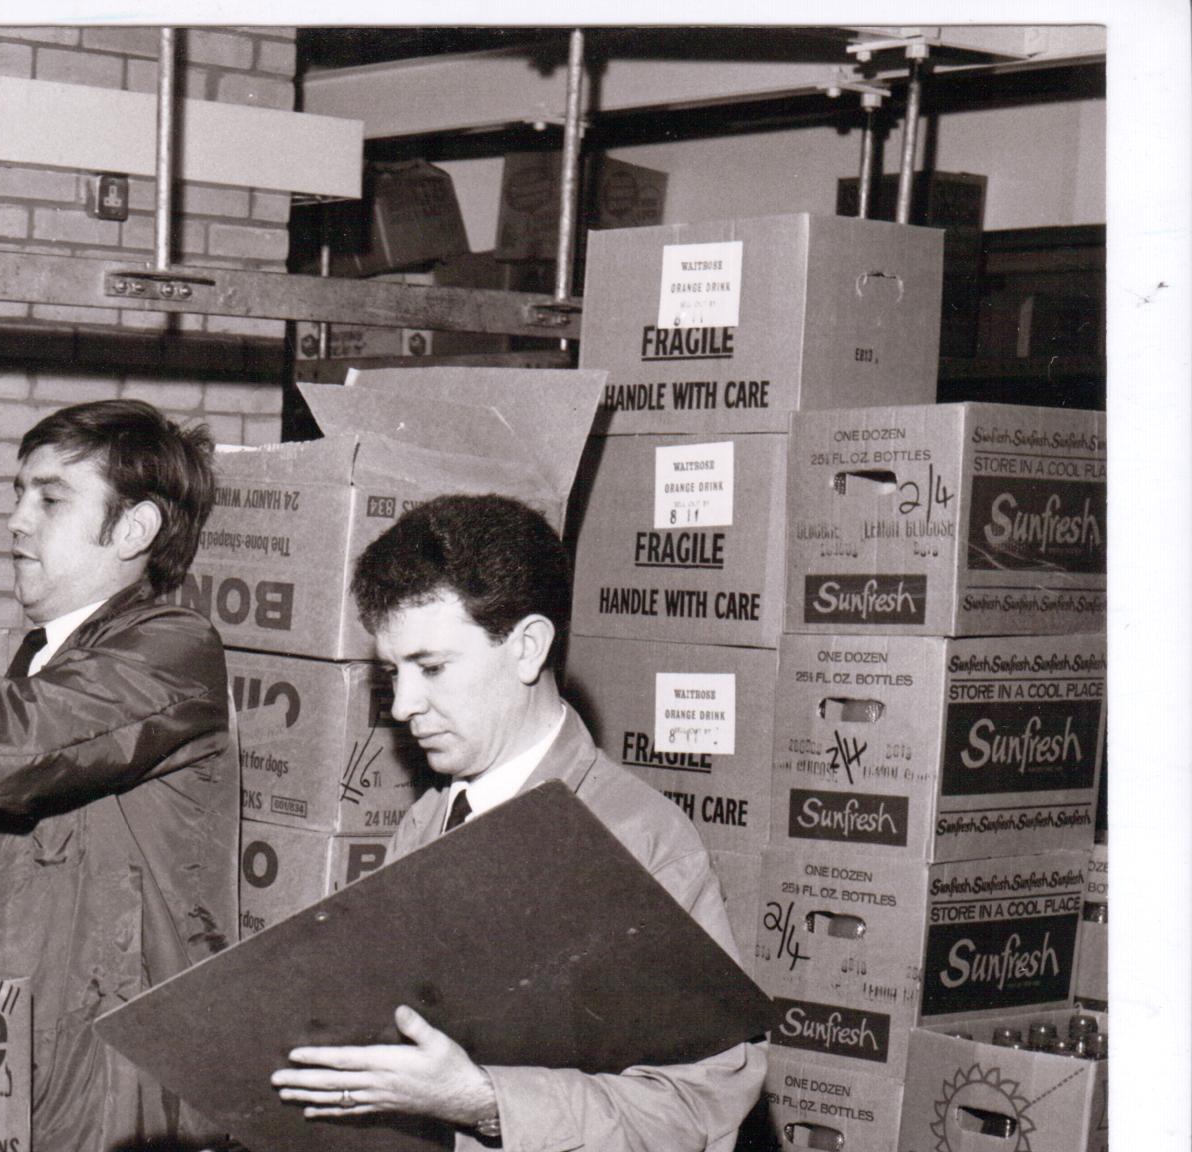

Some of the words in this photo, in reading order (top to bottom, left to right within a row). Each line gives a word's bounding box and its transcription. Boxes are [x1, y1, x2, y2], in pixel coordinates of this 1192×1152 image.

[681, 261, 723, 271] WAITROSE
[671, 283, 702, 294] ORANGE
[706, 282, 731, 293] DRINK
[641, 326, 734, 357] FRAGILE
[604, 383, 667, 412] HANDLE
[672, 382, 718, 410] WITH
[725, 381, 771, 409] CARE
[834, 430, 862, 442] ONE
[863, 428, 906, 441] DOZEN
[873, 450, 932, 463] BOTTLES
[673, 461, 715, 472] WAITROSE
[974, 457, 1017, 474] STORE
[1020, 459, 1032, 473] IN
[1048, 462, 1080, 477] COOL
[664, 483, 695, 494] ORANGE
[699, 482, 724, 492] DRINK
[635, 532, 725, 565] FRAGILE
[600, 588, 658, 616] HANDLE
[665, 589, 707, 618] WITH
[714, 592, 760, 621] CARE
[813, 580, 916, 619] Sunfresh
[818, 651, 843, 663] ONE
[844, 651, 888, 664] DOZEN
[855, 674, 914, 686] BOTTLES
[674, 689, 716, 700] WAITROSE
[948, 684, 994, 700] STORE
[998, 684, 1012, 698] IN
[1015, 684, 1025, 698] A
[1028, 683, 1064, 698] COOL
[1066, 682, 1103, 698] PLACE
[665, 709, 696, 720] ORANGE
[700, 710, 725, 721] DRINK
[960, 715, 1082, 775] Sunfresh
[265, 756, 289, 777] dogs
[365, 810, 381, 827] 24
[702, 796, 748, 827] CARE
[797, 797, 897, 838] Sunfresh
[805, 864, 831, 879] ONE
[832, 866, 873, 883] DOZEN
[841, 890, 897, 908] BOTTLES
[931, 904, 975, 922] STORE
[979, 903, 991, 918] IN
[993, 902, 1004, 917] A
[1007, 900, 1041, 917] COOL
[1045, 897, 1081, 915] PLACE
[940, 931, 1060, 991] Sunfresh
[779, 1007, 878, 1051] Sunfresh
[784, 1076, 808, 1090] ONE
[810, 1079, 851, 1097] DOZEN
[820, 1104, 874, 1123] BOTTLES
